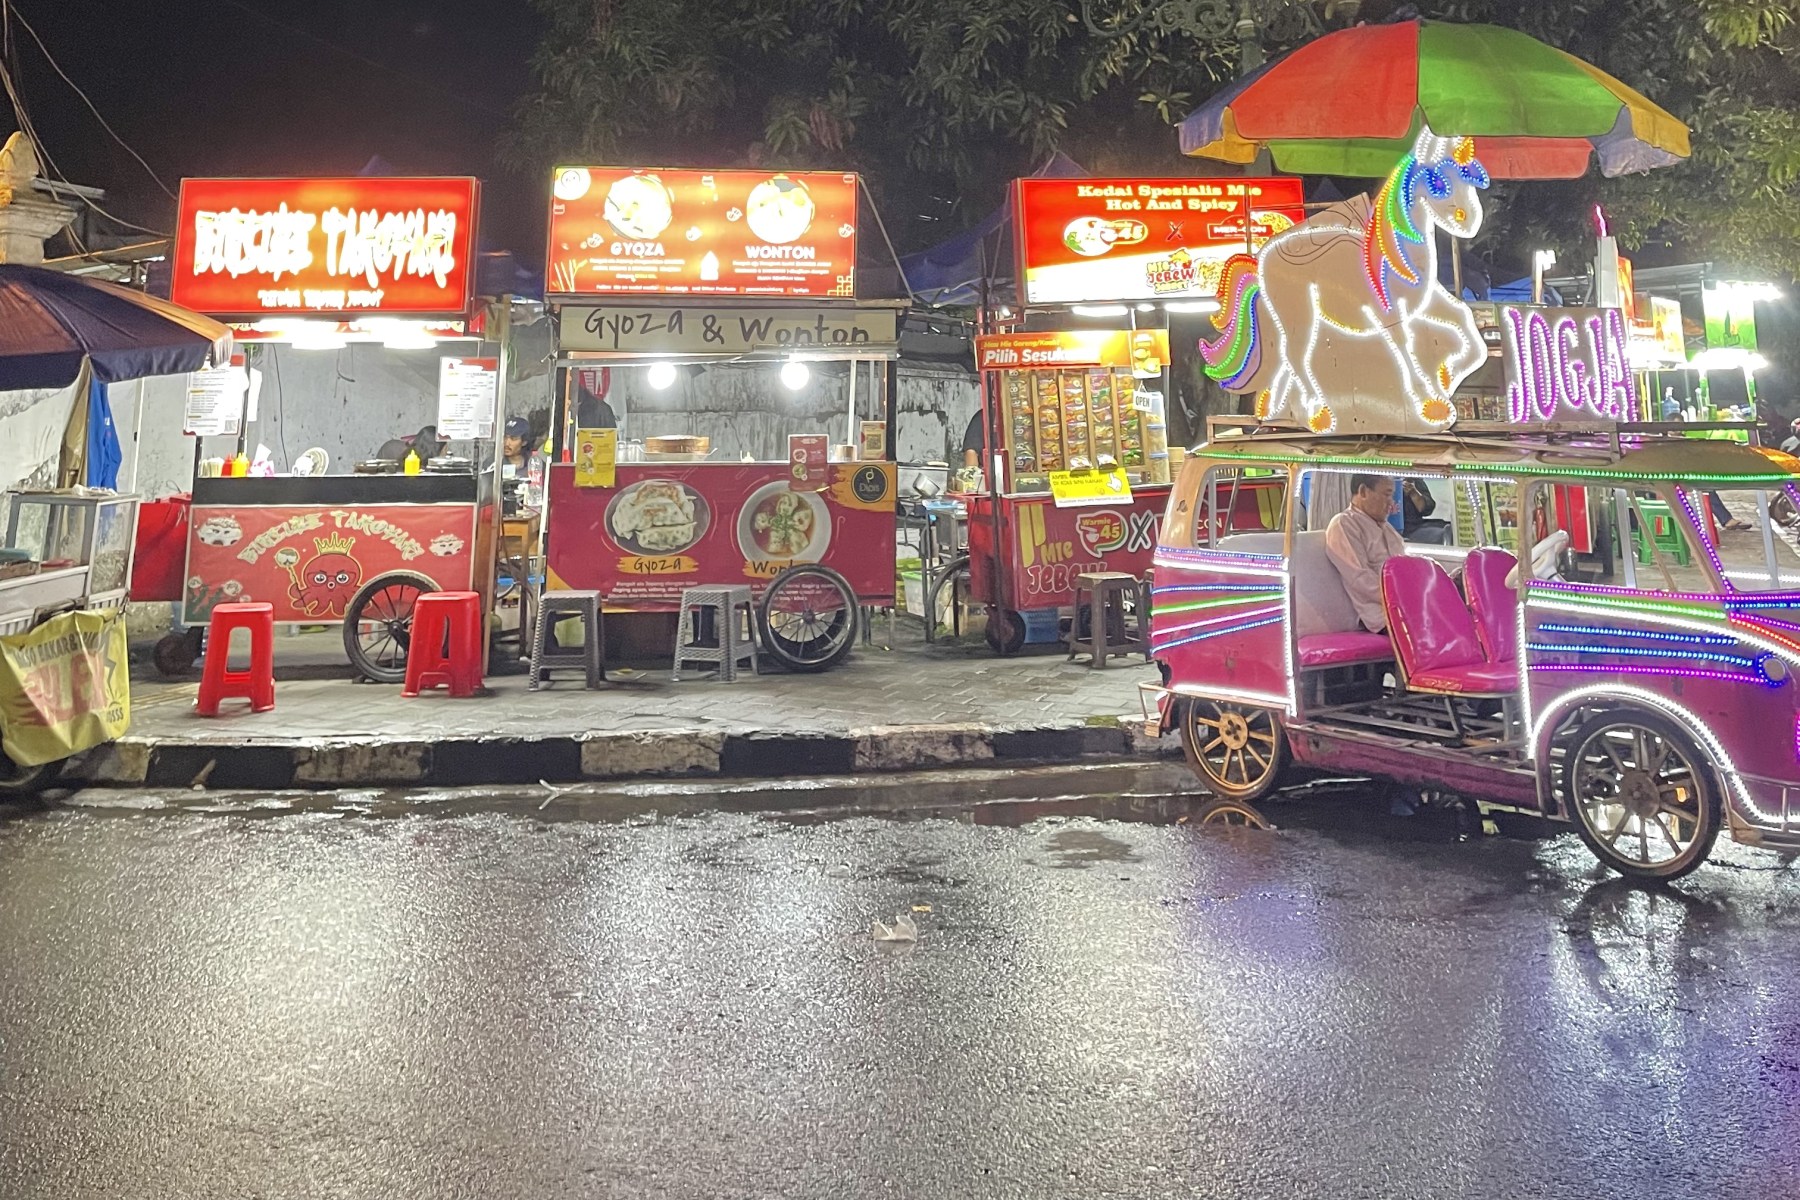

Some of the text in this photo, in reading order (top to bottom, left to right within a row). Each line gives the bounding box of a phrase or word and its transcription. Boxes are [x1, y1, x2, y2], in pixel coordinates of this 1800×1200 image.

[1077, 184, 1262, 199] Kedai Spesialis Me
[1106, 198, 1238, 213] Hot And Spicy
[610, 241, 665, 257] GYOZA
[745, 245, 815, 259] WONTON
[584, 308, 869, 349] Gyoza & Wonton
[983, 348, 1018, 366] Pilih
[1503, 305, 1638, 423] JOGJA
[1135, 395, 1150, 409] OPEN
[1081, 517, 1112, 527] Warmie
[1100, 523, 1120, 539] 45
[633, 557, 682, 575] Gyoza
[752, 559, 794, 576] Won
